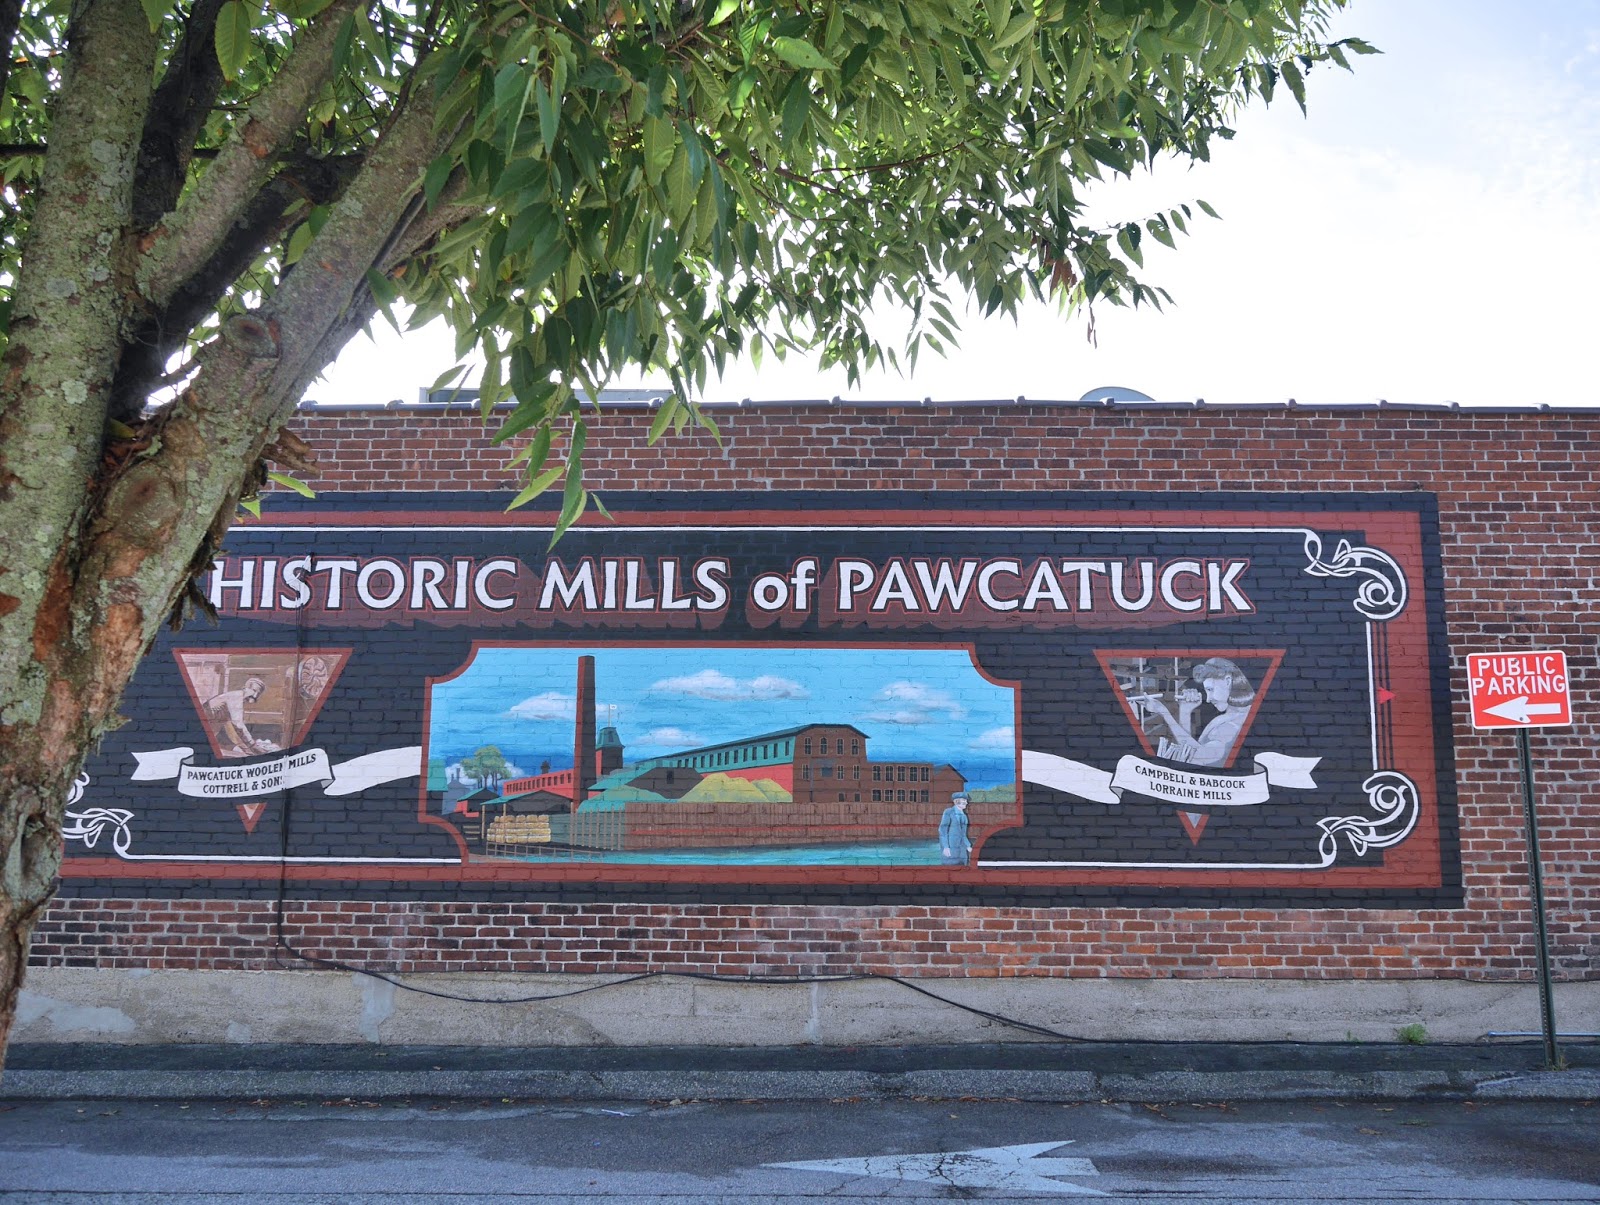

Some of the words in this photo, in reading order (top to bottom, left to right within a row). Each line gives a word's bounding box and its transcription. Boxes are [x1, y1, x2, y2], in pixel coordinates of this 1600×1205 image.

[210, 555, 518, 611] HISTORIC
[539, 559, 726, 611] MILLS
[752, 560, 815, 611] of
[834, 561, 1252, 612] PAWCATUCK
[1477, 656, 1556, 677] PUBLIC
[1471, 674, 1566, 696] PARKING
[187, 769, 243, 781] PAWCATUCK
[288, 753, 316, 769] MILLS
[1135, 765, 1187, 784] CAMPBELL
[1189, 776, 1198, 786] &
[1199, 777, 1246, 789] BABCOCK
[202, 782, 250, 794] COTTRELL
[251, 781, 259, 791] &
[1149, 781, 1200, 799] LORRAINE
[1203, 790, 1232, 801] MILLS
